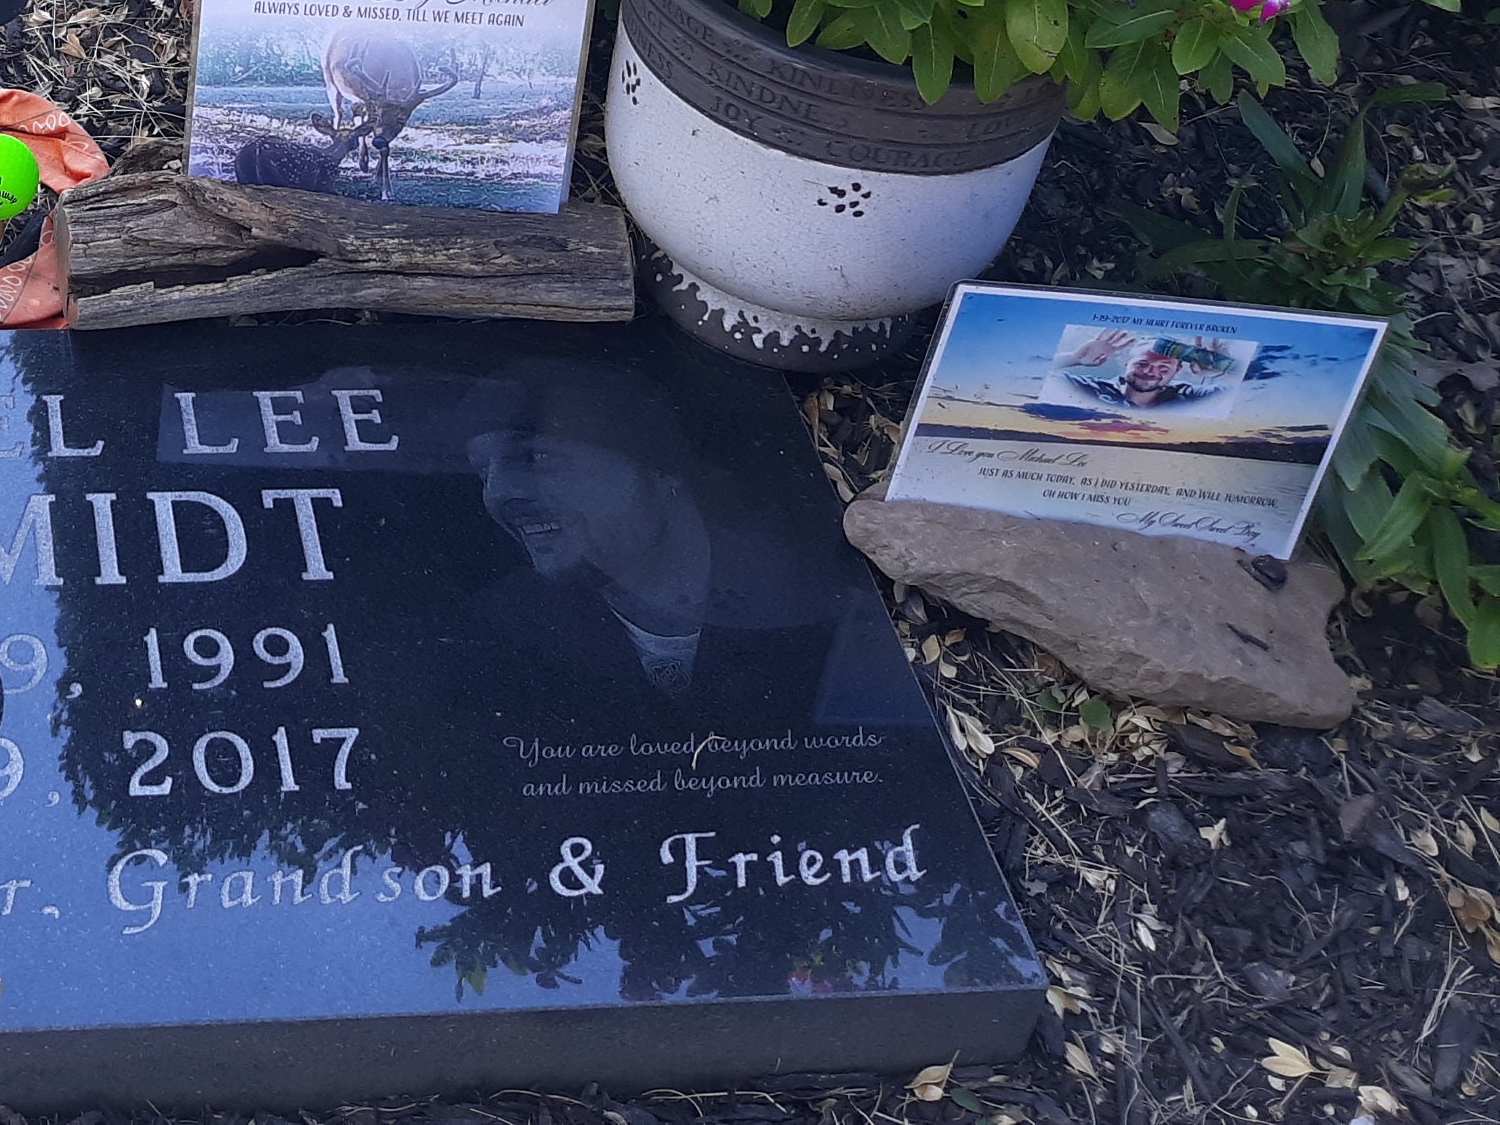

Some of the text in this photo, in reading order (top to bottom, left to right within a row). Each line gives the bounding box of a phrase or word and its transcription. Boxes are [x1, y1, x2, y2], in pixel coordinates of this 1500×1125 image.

[254, 0, 525, 27] ALWAYS LOVED & MISSED, TILL WE MEET AGAIN
[710, 95, 762, 127] JOY
[1171, 320, 1204, 331] FOREVER
[1206, 324, 1238, 334] BROKEN
[173, 389, 399, 455] LEE
[940, 441, 974, 457] Love
[967, 452, 995, 463] you
[997, 448, 1064, 465] Michael
[1059, 452, 1090, 467] Lee
[978, 466, 1000, 477] JUST
[1001, 469, 1014, 478] AS
[1015, 470, 1043, 482] MUCH
[1080, 477, 1093, 487] AS
[1100, 478, 1117, 489] DID
[1175, 488, 1197, 498] AND
[1198, 489, 1221, 501] WILL
[1042, 488, 1056, 498] OH
[1057, 490, 1080, 501] HOW
[1086, 493, 1110, 504] MISS
[1112, 496, 1132, 507] YOU
[1116, 511, 1261, 543] My Sweet Sweet Boy
[142, 622, 349, 690] 1991
[121, 726, 360, 797] 2017
[502, 726, 885, 768] You are loved beyond words
[522, 766, 884, 798] and missed beyond measure.
[547, 833, 607, 898] &
[660, 822, 929, 904] Friend
